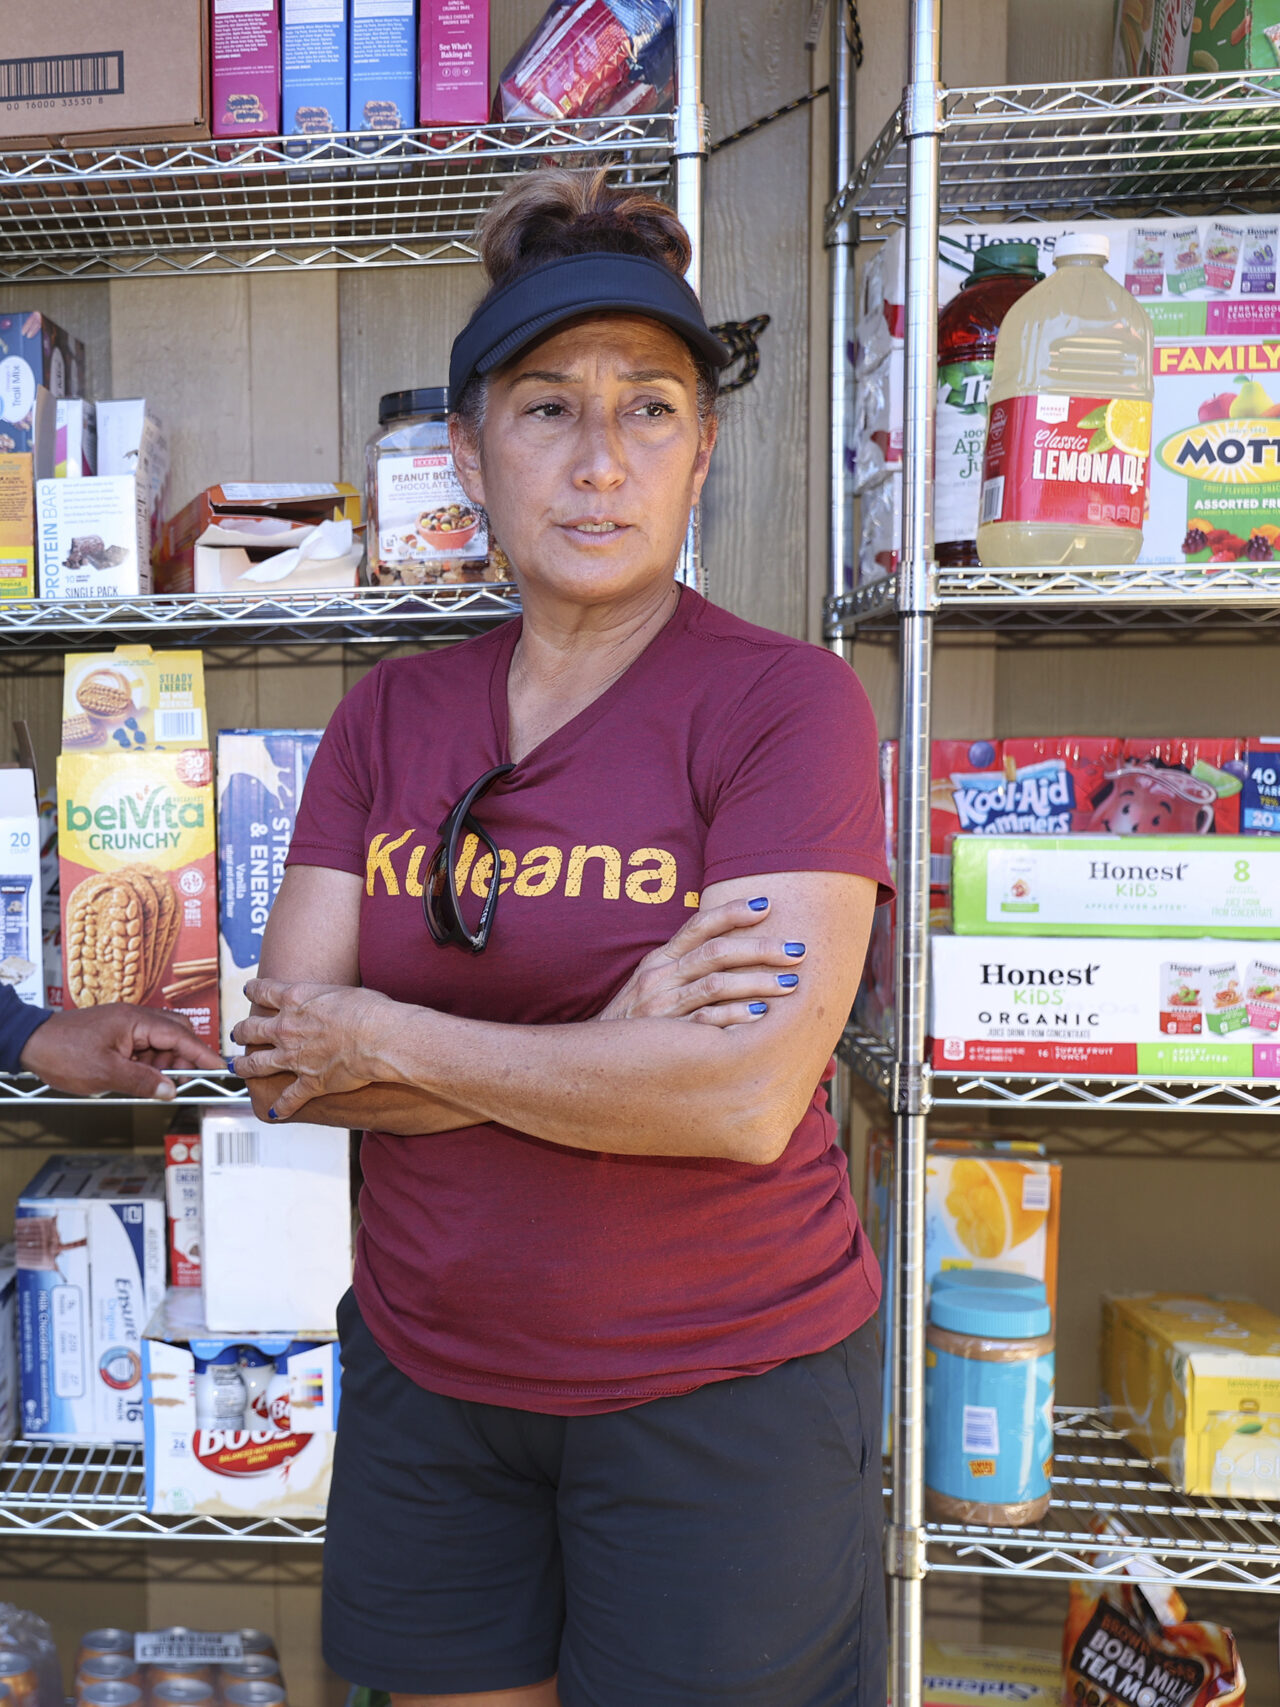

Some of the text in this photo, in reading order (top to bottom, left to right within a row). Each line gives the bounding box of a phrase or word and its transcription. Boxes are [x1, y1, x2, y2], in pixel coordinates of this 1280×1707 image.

[439, 42, 472, 51] See What's
[441, 51, 462, 60] Baking
[7, 103, 20, 111] 00
[26, 100, 56, 109] 16000
[62, 97, 92, 107] 33530
[1228, 312, 1275, 320] LEMONADE
[13, 364, 22, 407] Trail Mix
[1034, 428, 1088, 450] Classic
[1032, 449, 1146, 487] LEMONADE
[395, 481, 450, 491] CHOCOLATE
[1194, 498, 1259, 510] ASSORTED
[41, 484, 60, 599] PROTEIN BAR
[65, 586, 119, 599] SINGLE PACK
[159, 674, 193, 683] STEADY
[159, 683, 193, 692] ENERGY
[1251, 767, 1277, 785] 40
[953, 764, 1071, 827] Kool-Aid
[66, 785, 204, 831] belVita
[1252, 810, 1274, 827] 20
[10, 832, 30, 847] 20
[89, 832, 182, 851] CRUNCHY
[272, 817, 291, 895] STREN
[250, 822, 269, 936] & ENERGY
[1087, 861, 1189, 881] Honest
[1233, 860, 1250, 882] 8
[235, 863, 247, 899] Vanilla
[1116, 883, 1158, 897] KiDS
[979, 963, 1101, 986] Honest
[1013, 989, 1065, 1005] KiDS
[978, 1011, 1100, 1026] ORGANIC
[986, 1028, 1091, 1039] JUICE DRINK FROM CONCENTRATE
[1055, 1046, 1114, 1055] SUPER FRUIT
[115, 1278, 138, 1341] Ensure
[38, 1290, 49, 1361] Milk Chocolate
[127, 1399, 143, 1422] 16
[1087, 1628, 1193, 1701] BOBA MILK
